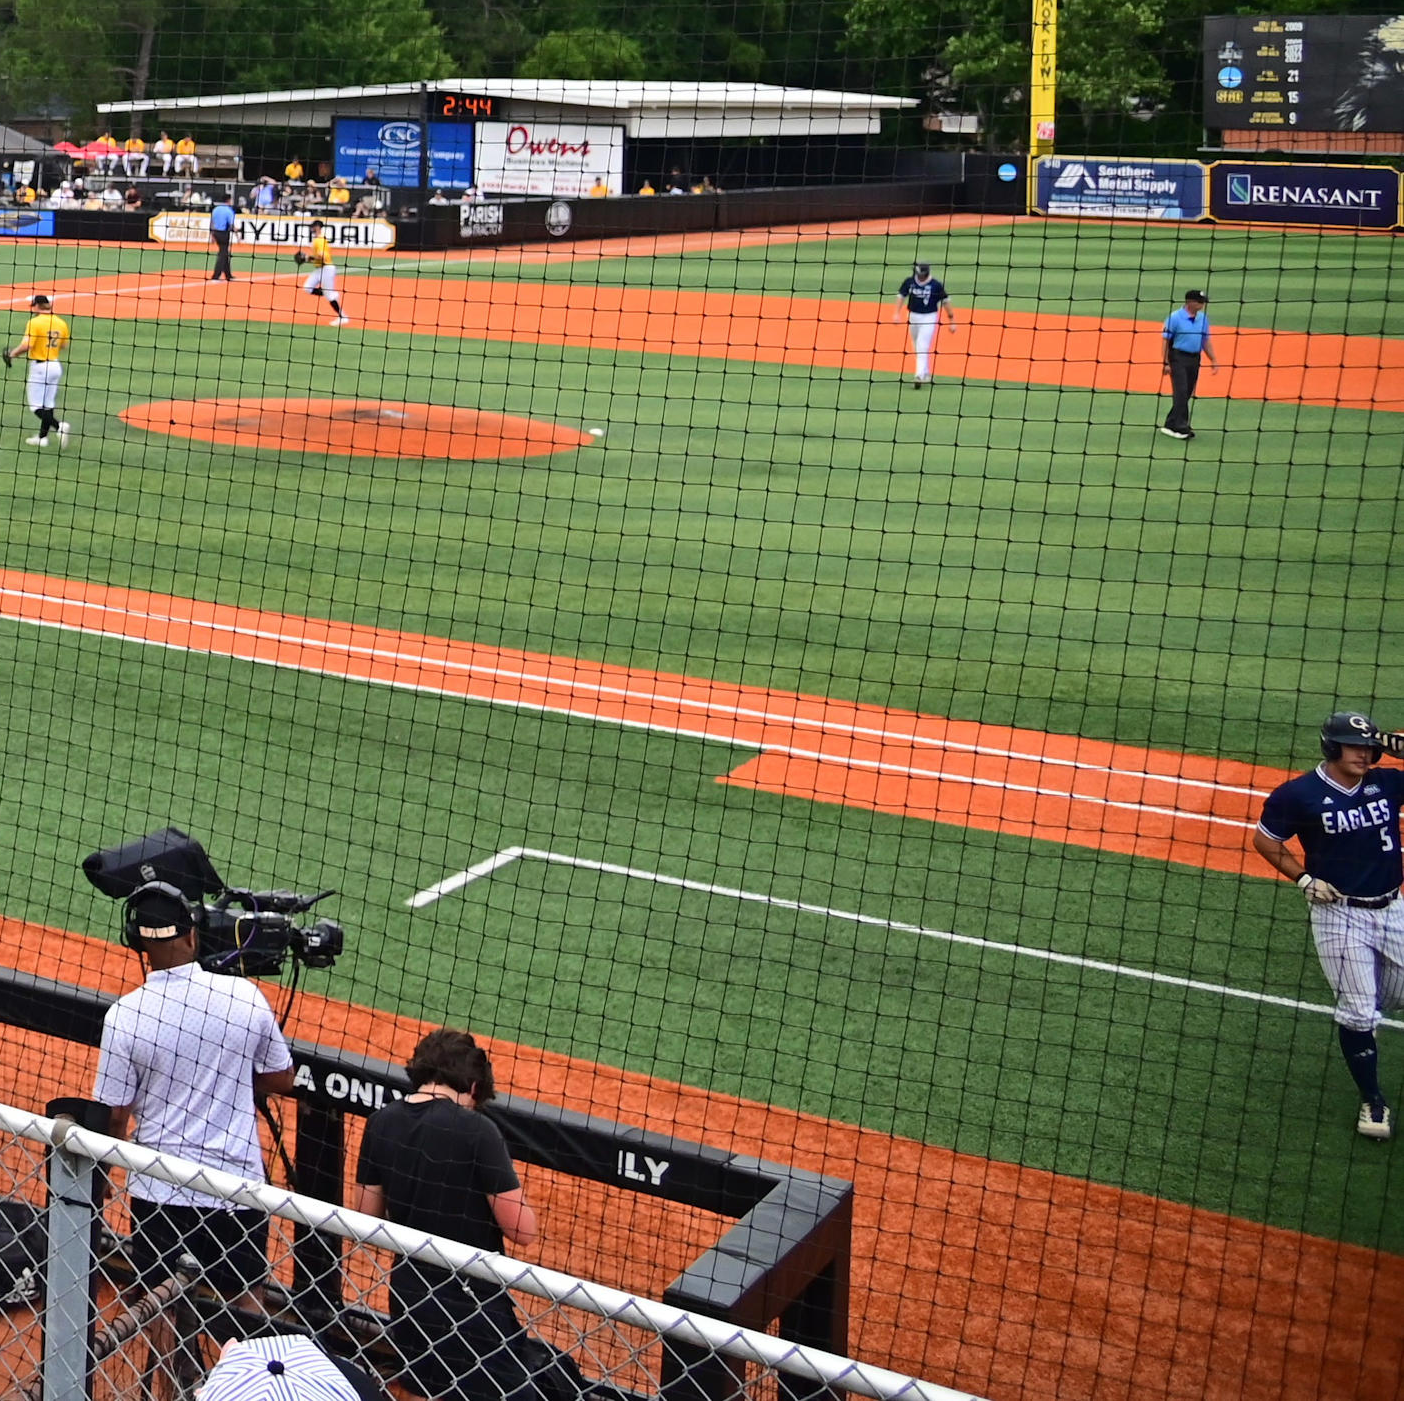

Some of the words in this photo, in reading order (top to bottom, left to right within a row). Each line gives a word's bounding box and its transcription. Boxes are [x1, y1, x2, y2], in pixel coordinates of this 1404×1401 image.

[443, 96, 492, 116] 2:44
[1287, 92, 1299, 103] 15
[1289, 112, 1297, 124] 9
[507, 124, 590, 156] Owens
[1098, 164, 1155, 178] Southern
[1098, 177, 1132, 190] Metal
[1134, 180, 1177, 194] Supply
[1252, 185, 1381, 207] RENASANT
[1321, 798, 1390, 834] EAGLES
[1380, 826, 1393, 852] 5
